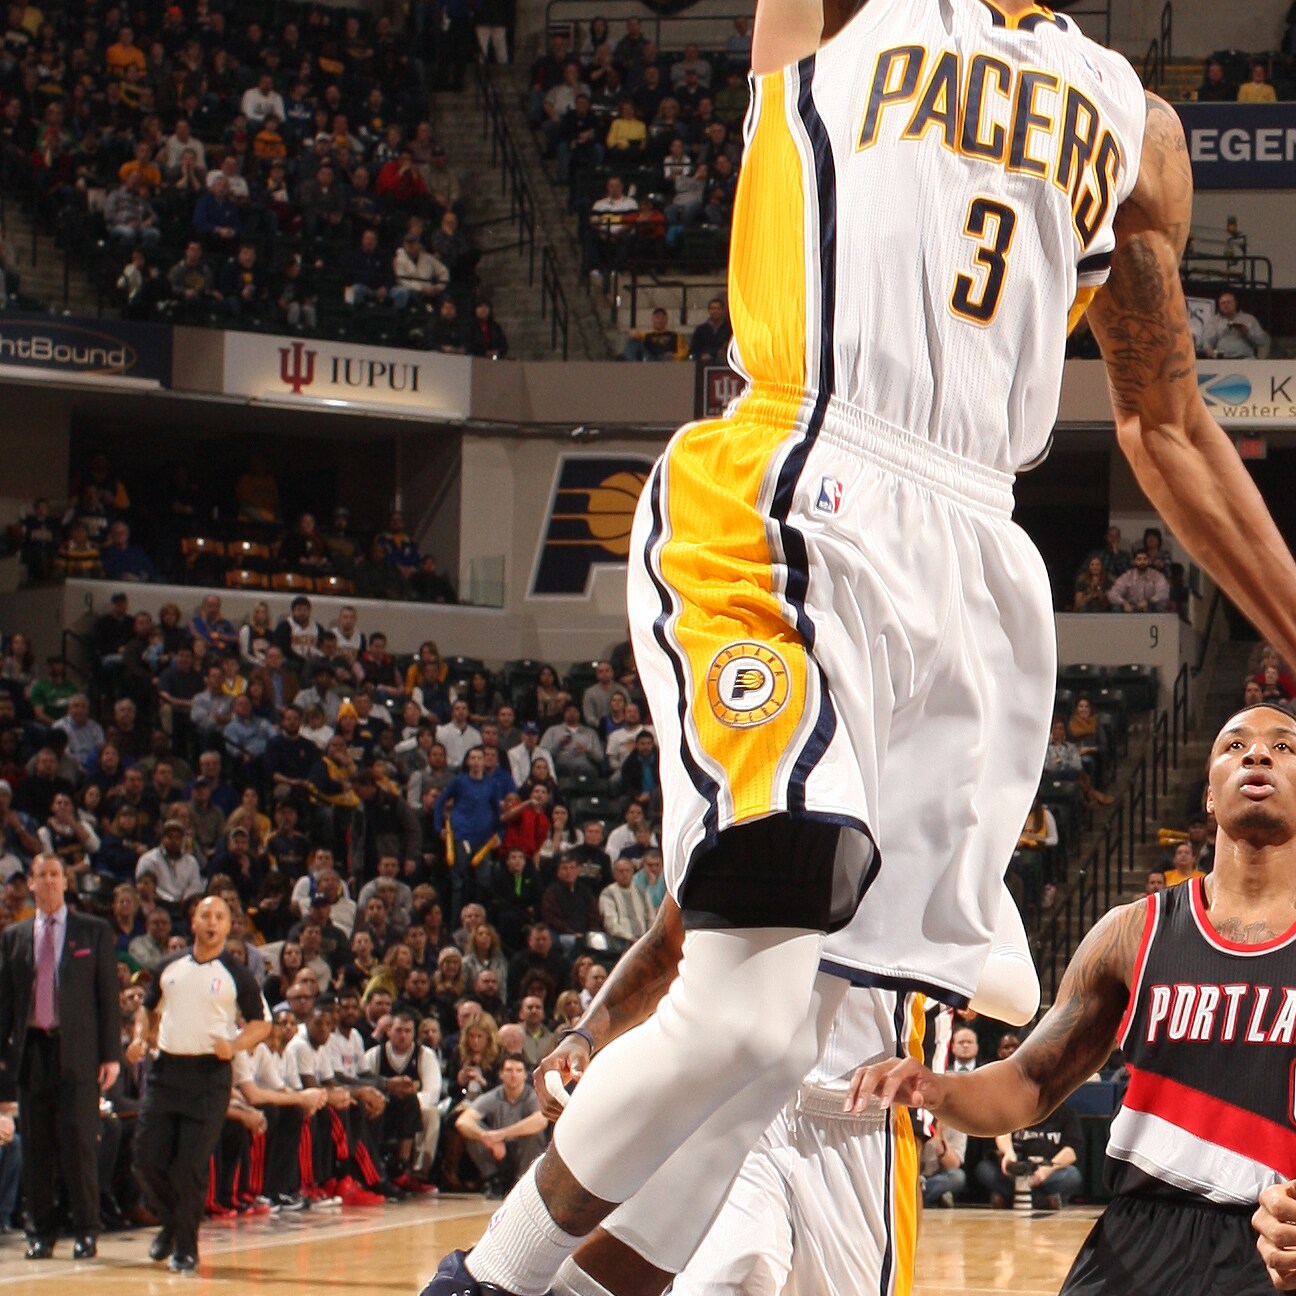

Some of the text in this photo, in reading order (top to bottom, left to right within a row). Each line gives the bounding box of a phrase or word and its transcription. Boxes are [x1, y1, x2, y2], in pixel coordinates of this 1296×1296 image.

[855, 44, 1121, 253] PACERS
[948, 194, 1019, 328] 3
[330, 356, 421, 393] IUPUI
[1223, 403, 1279, 418] water
[1149, 625, 1158, 648] 9
